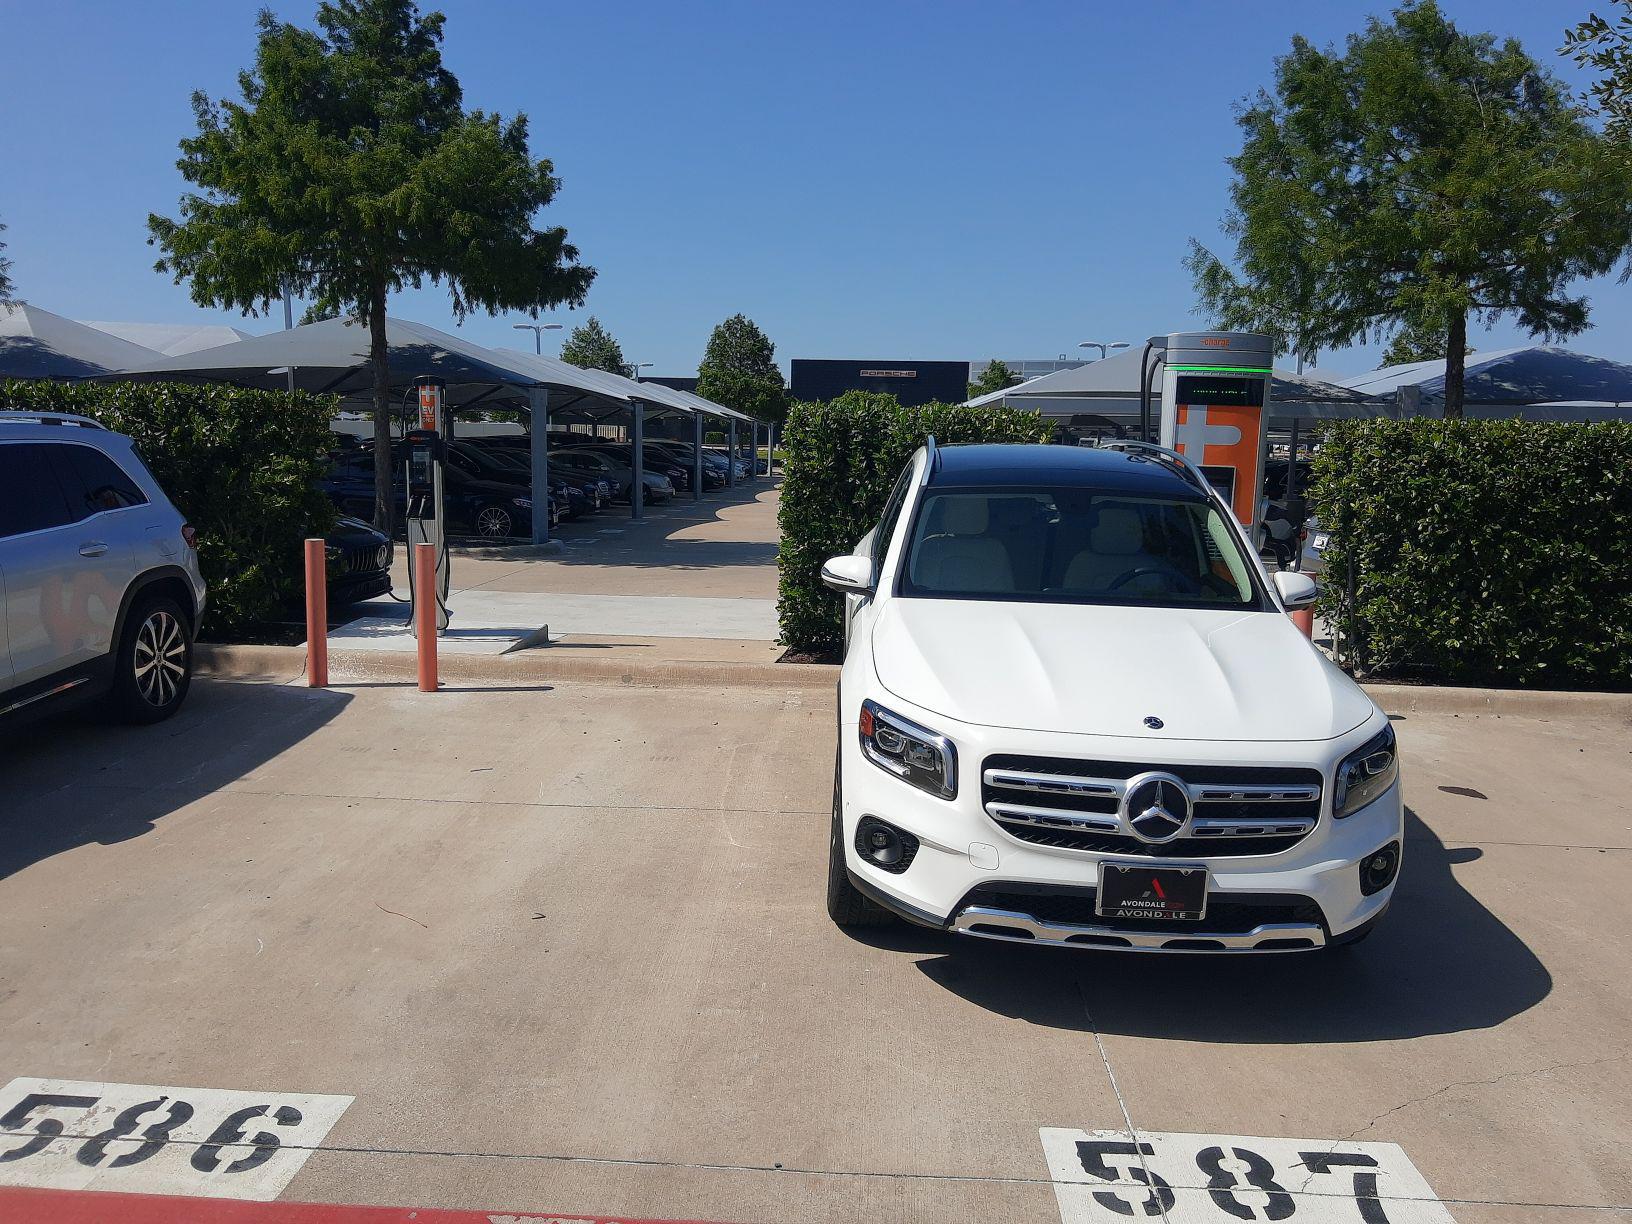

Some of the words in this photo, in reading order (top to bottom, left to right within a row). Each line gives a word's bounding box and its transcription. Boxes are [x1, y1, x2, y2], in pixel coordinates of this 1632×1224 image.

[860, 369, 917, 378] PORSCHE
[421, 406, 434, 414] EV
[1121, 900, 1166, 908] AVONDALE
[0, 1094, 303, 1174] 586
[1075, 1140, 1391, 1224] 587
